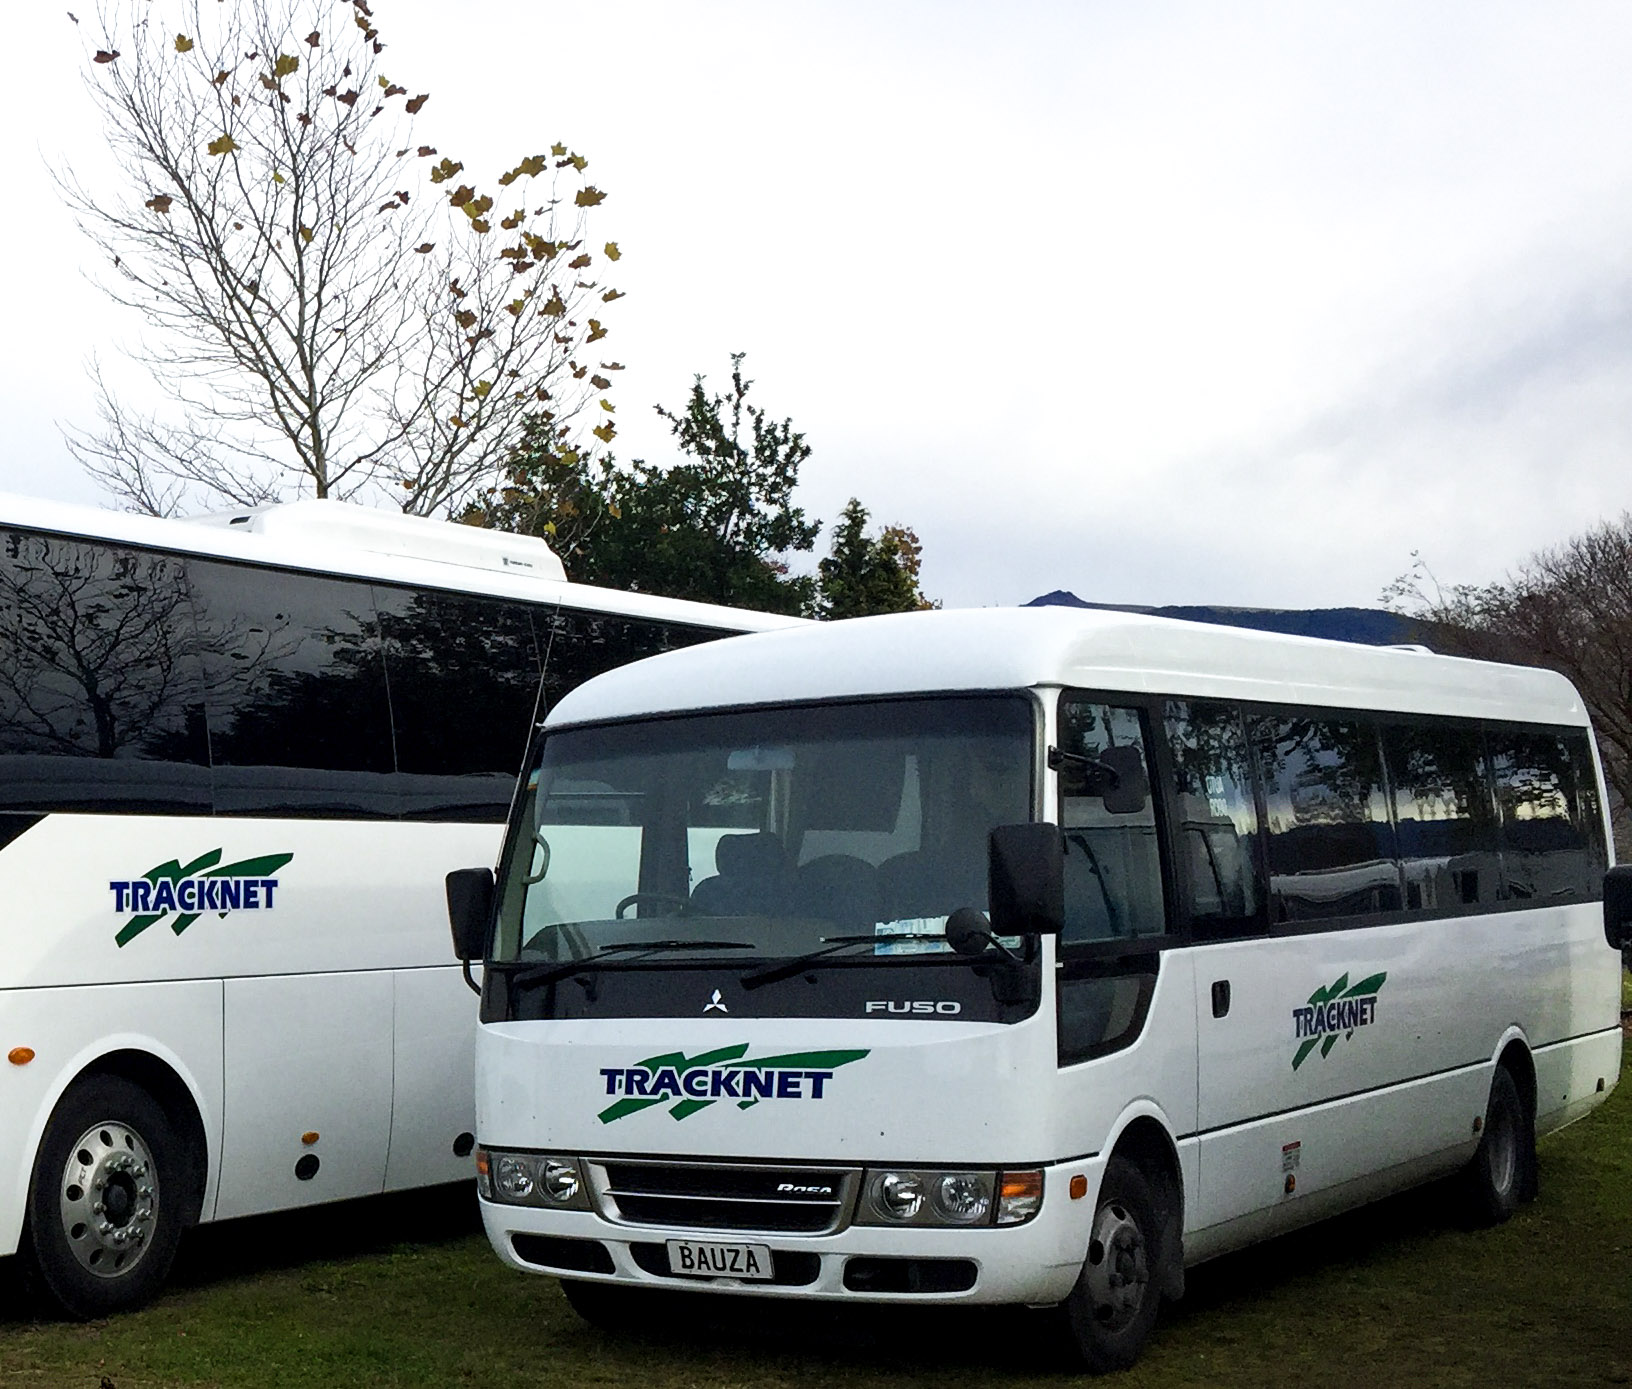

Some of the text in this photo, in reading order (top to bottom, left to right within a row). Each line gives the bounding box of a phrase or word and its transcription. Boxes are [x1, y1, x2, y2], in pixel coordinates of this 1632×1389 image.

[110, 879, 278, 912] TRACKNET
[865, 1001, 961, 1014] FUSO
[1293, 996, 1377, 1038] TRACKNET
[600, 1068, 833, 1099] TRACKNET
[679, 1245, 761, 1274] BAUZA
